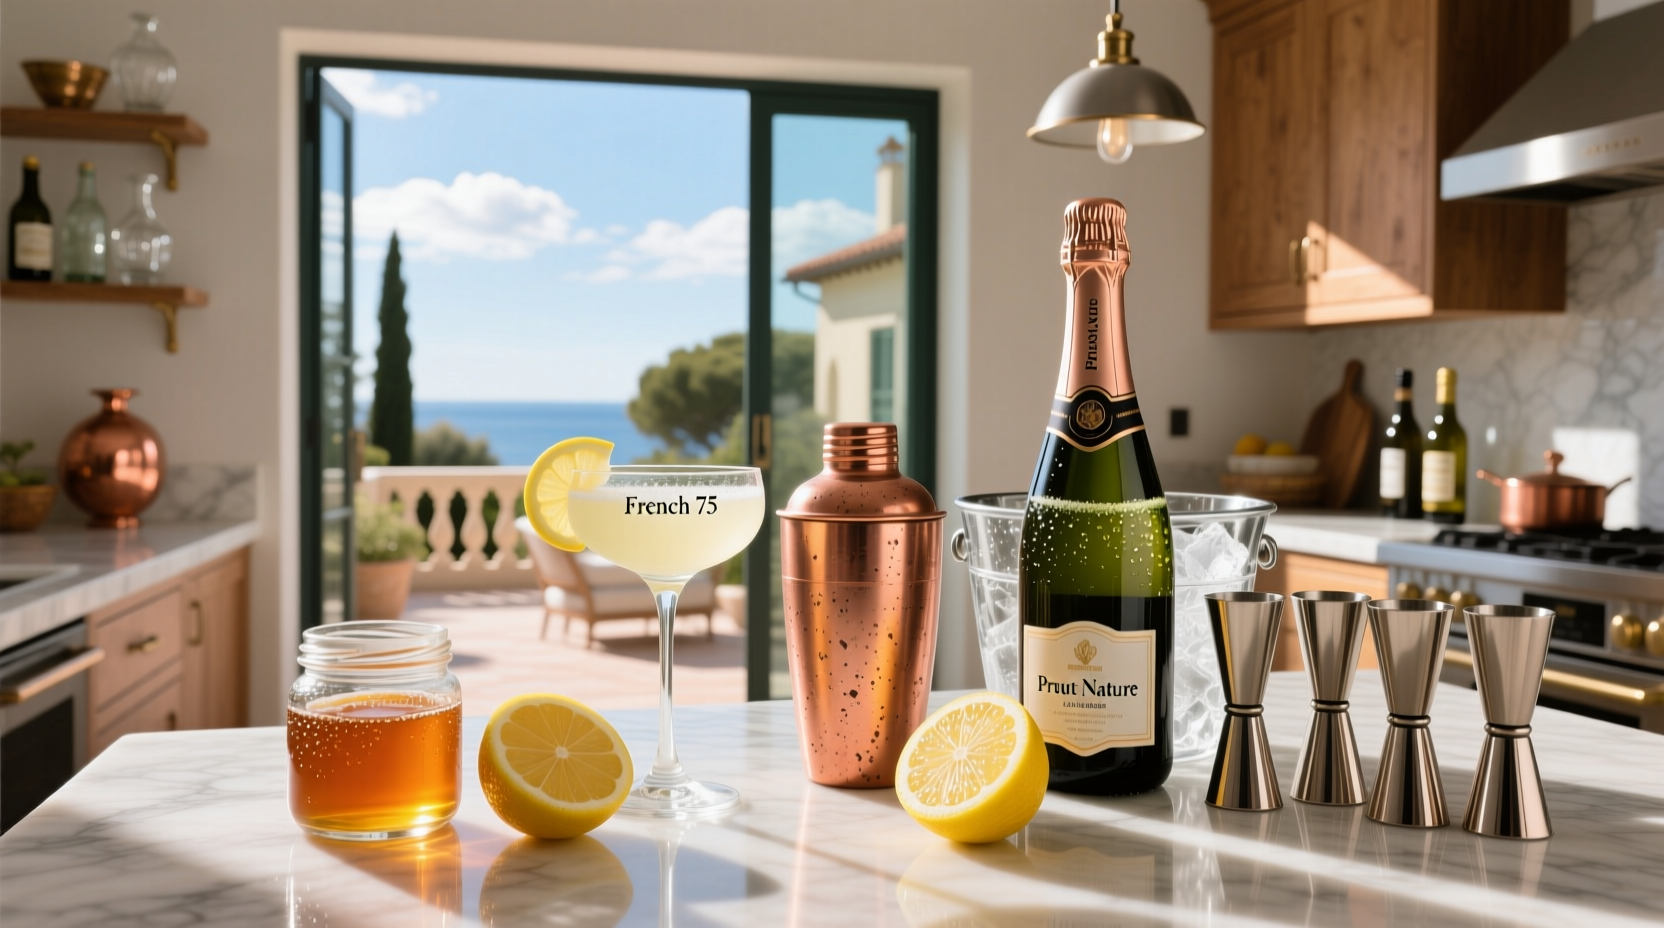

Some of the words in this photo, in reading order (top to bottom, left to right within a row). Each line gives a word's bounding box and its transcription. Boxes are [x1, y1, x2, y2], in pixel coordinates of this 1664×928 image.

[624, 495, 690, 515] French
[696, 495, 717, 515] 75
[1081, 678, 1138, 697] Nature
